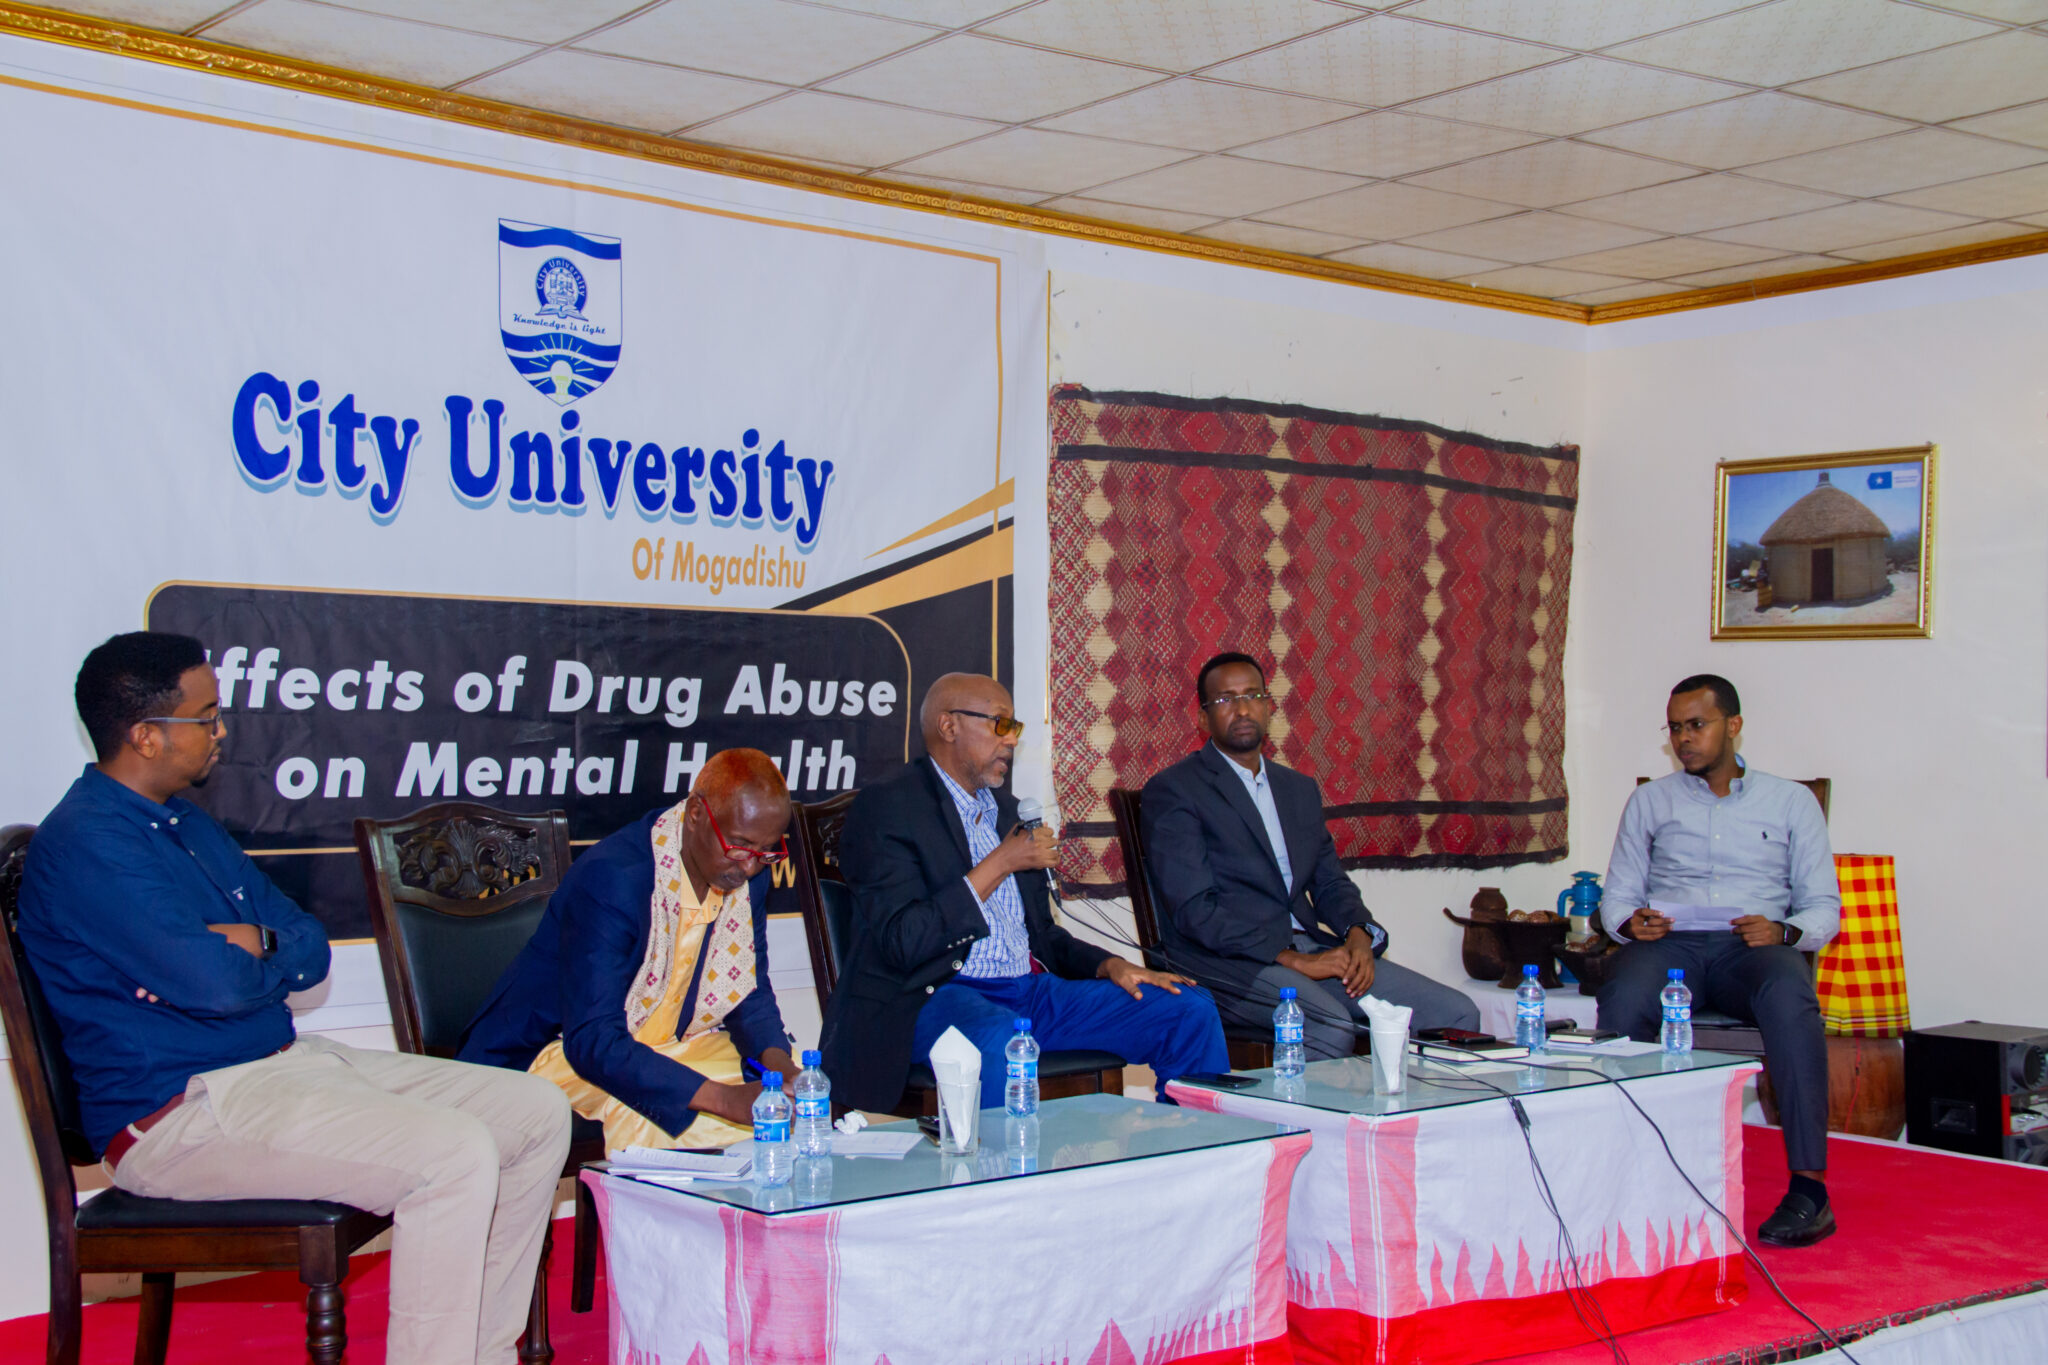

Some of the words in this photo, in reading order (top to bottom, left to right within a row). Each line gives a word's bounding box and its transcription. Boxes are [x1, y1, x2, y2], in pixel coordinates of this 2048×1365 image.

[536, 267, 548, 290] City
[549, 259, 586, 297] University
[513, 313, 567, 330] Knowledge
[570, 322, 578, 331] is
[582, 324, 607, 335] light
[232, 371, 421, 525] City
[444, 394, 833, 553] University
[632, 537, 666, 582] Of
[671, 541, 806, 595] Mogadishu
[205, 646, 425, 712] ffects
[454, 655, 527, 713] of
[548, 659, 702, 728] Drug
[724, 663, 897, 717] Abuse
[275, 756, 366, 800] on
[395, 739, 640, 798] Mental
[663, 739, 857, 793] Hlth
